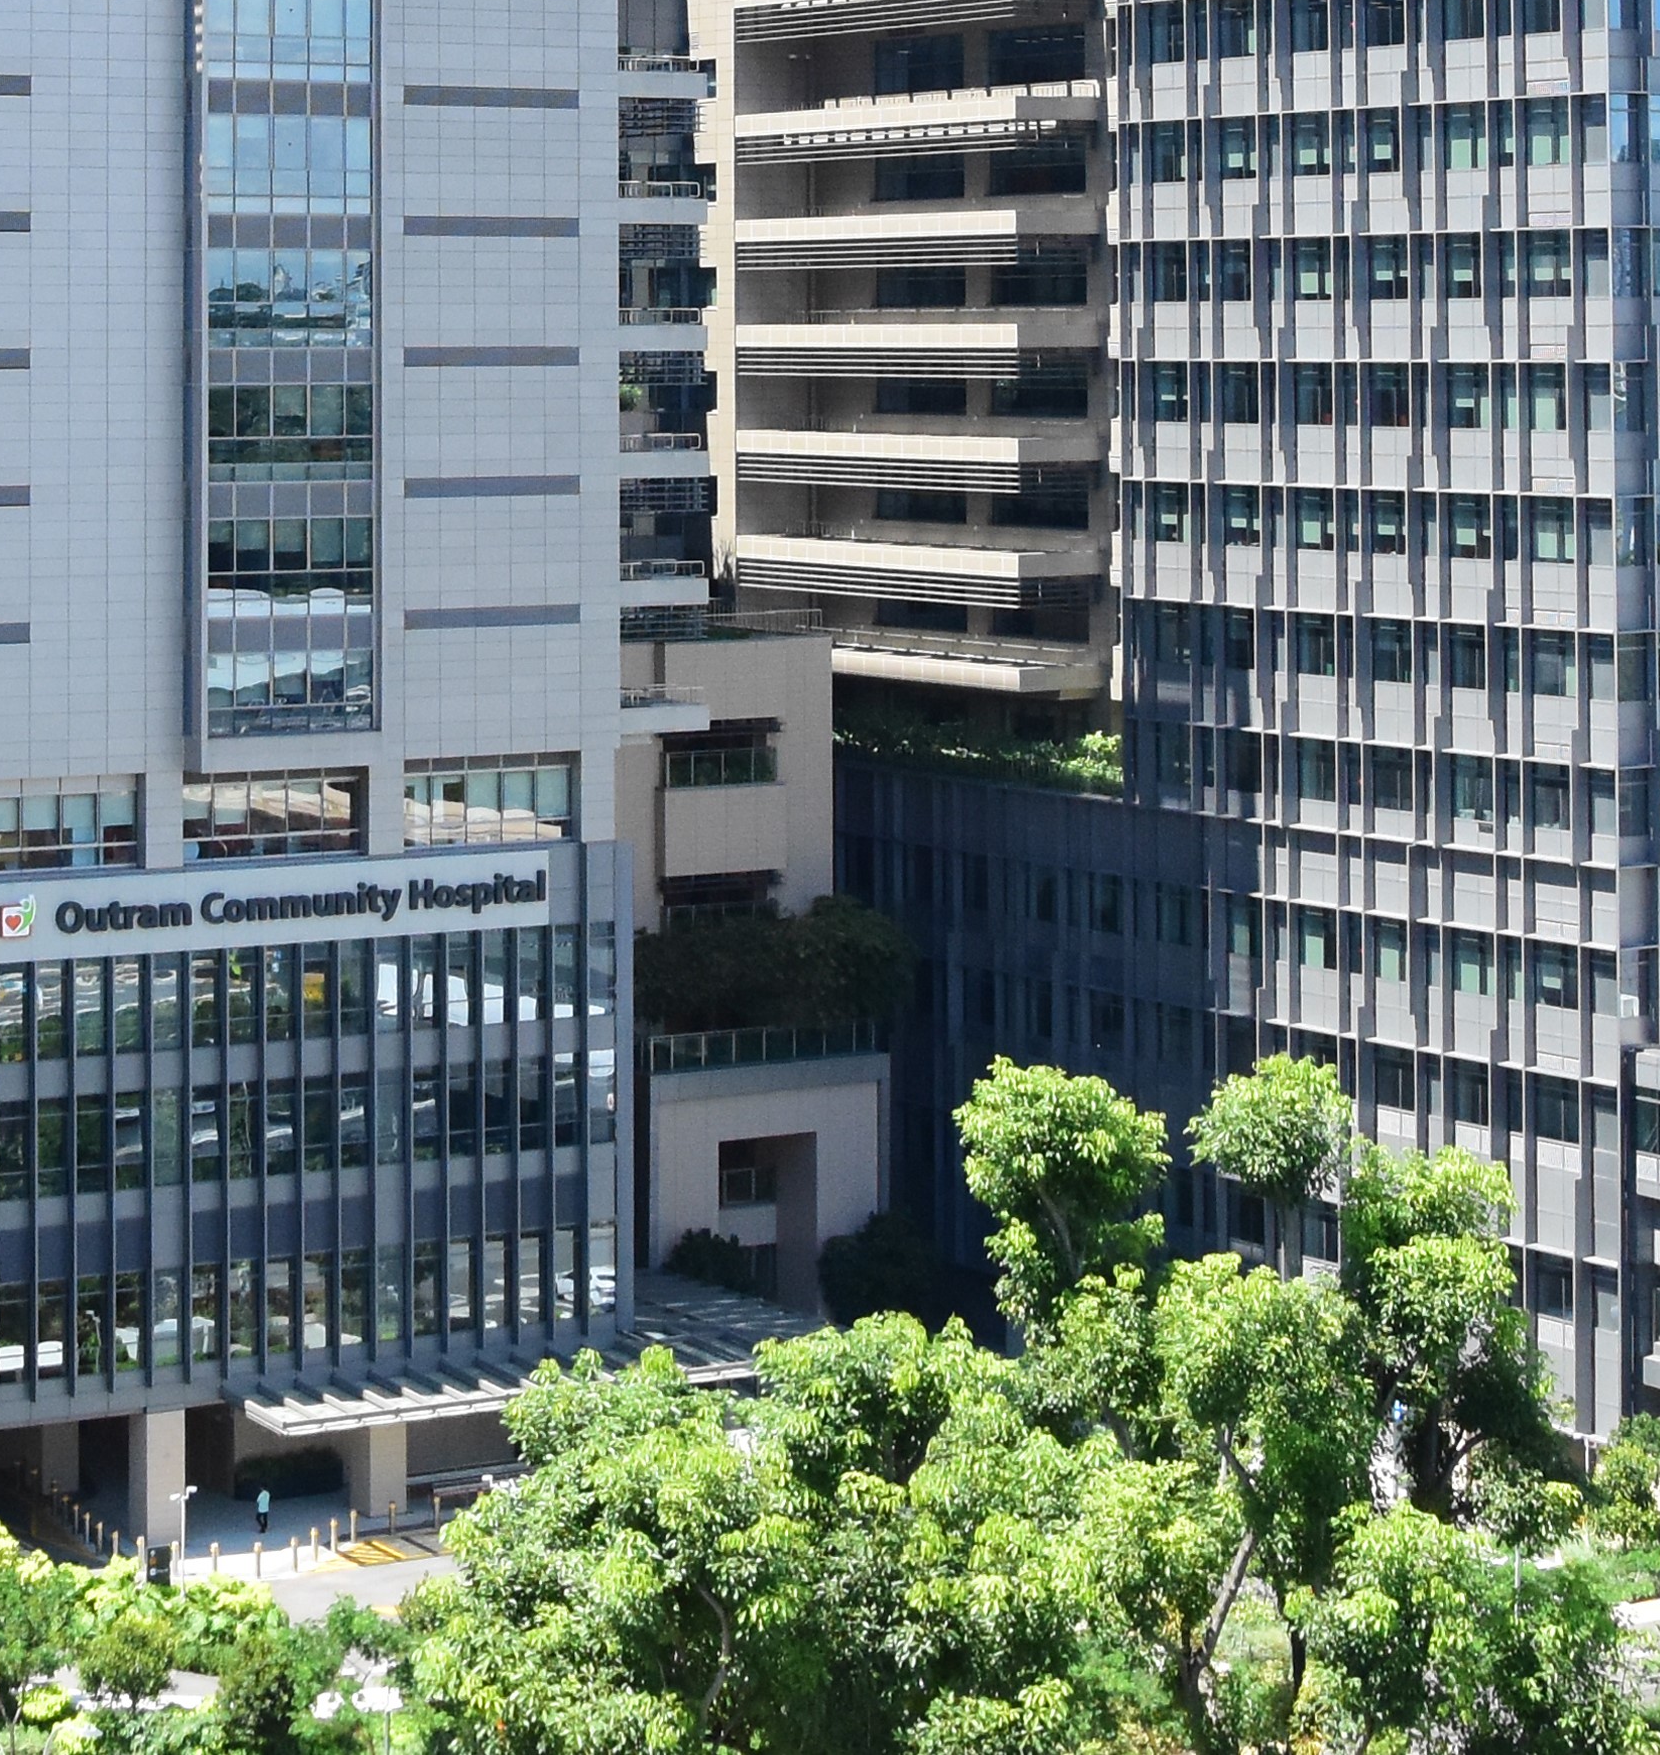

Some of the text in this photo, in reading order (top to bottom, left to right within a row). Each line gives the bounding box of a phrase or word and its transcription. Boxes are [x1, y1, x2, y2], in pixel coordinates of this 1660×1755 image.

[55, 869, 547, 934] Outram Community Hospital
